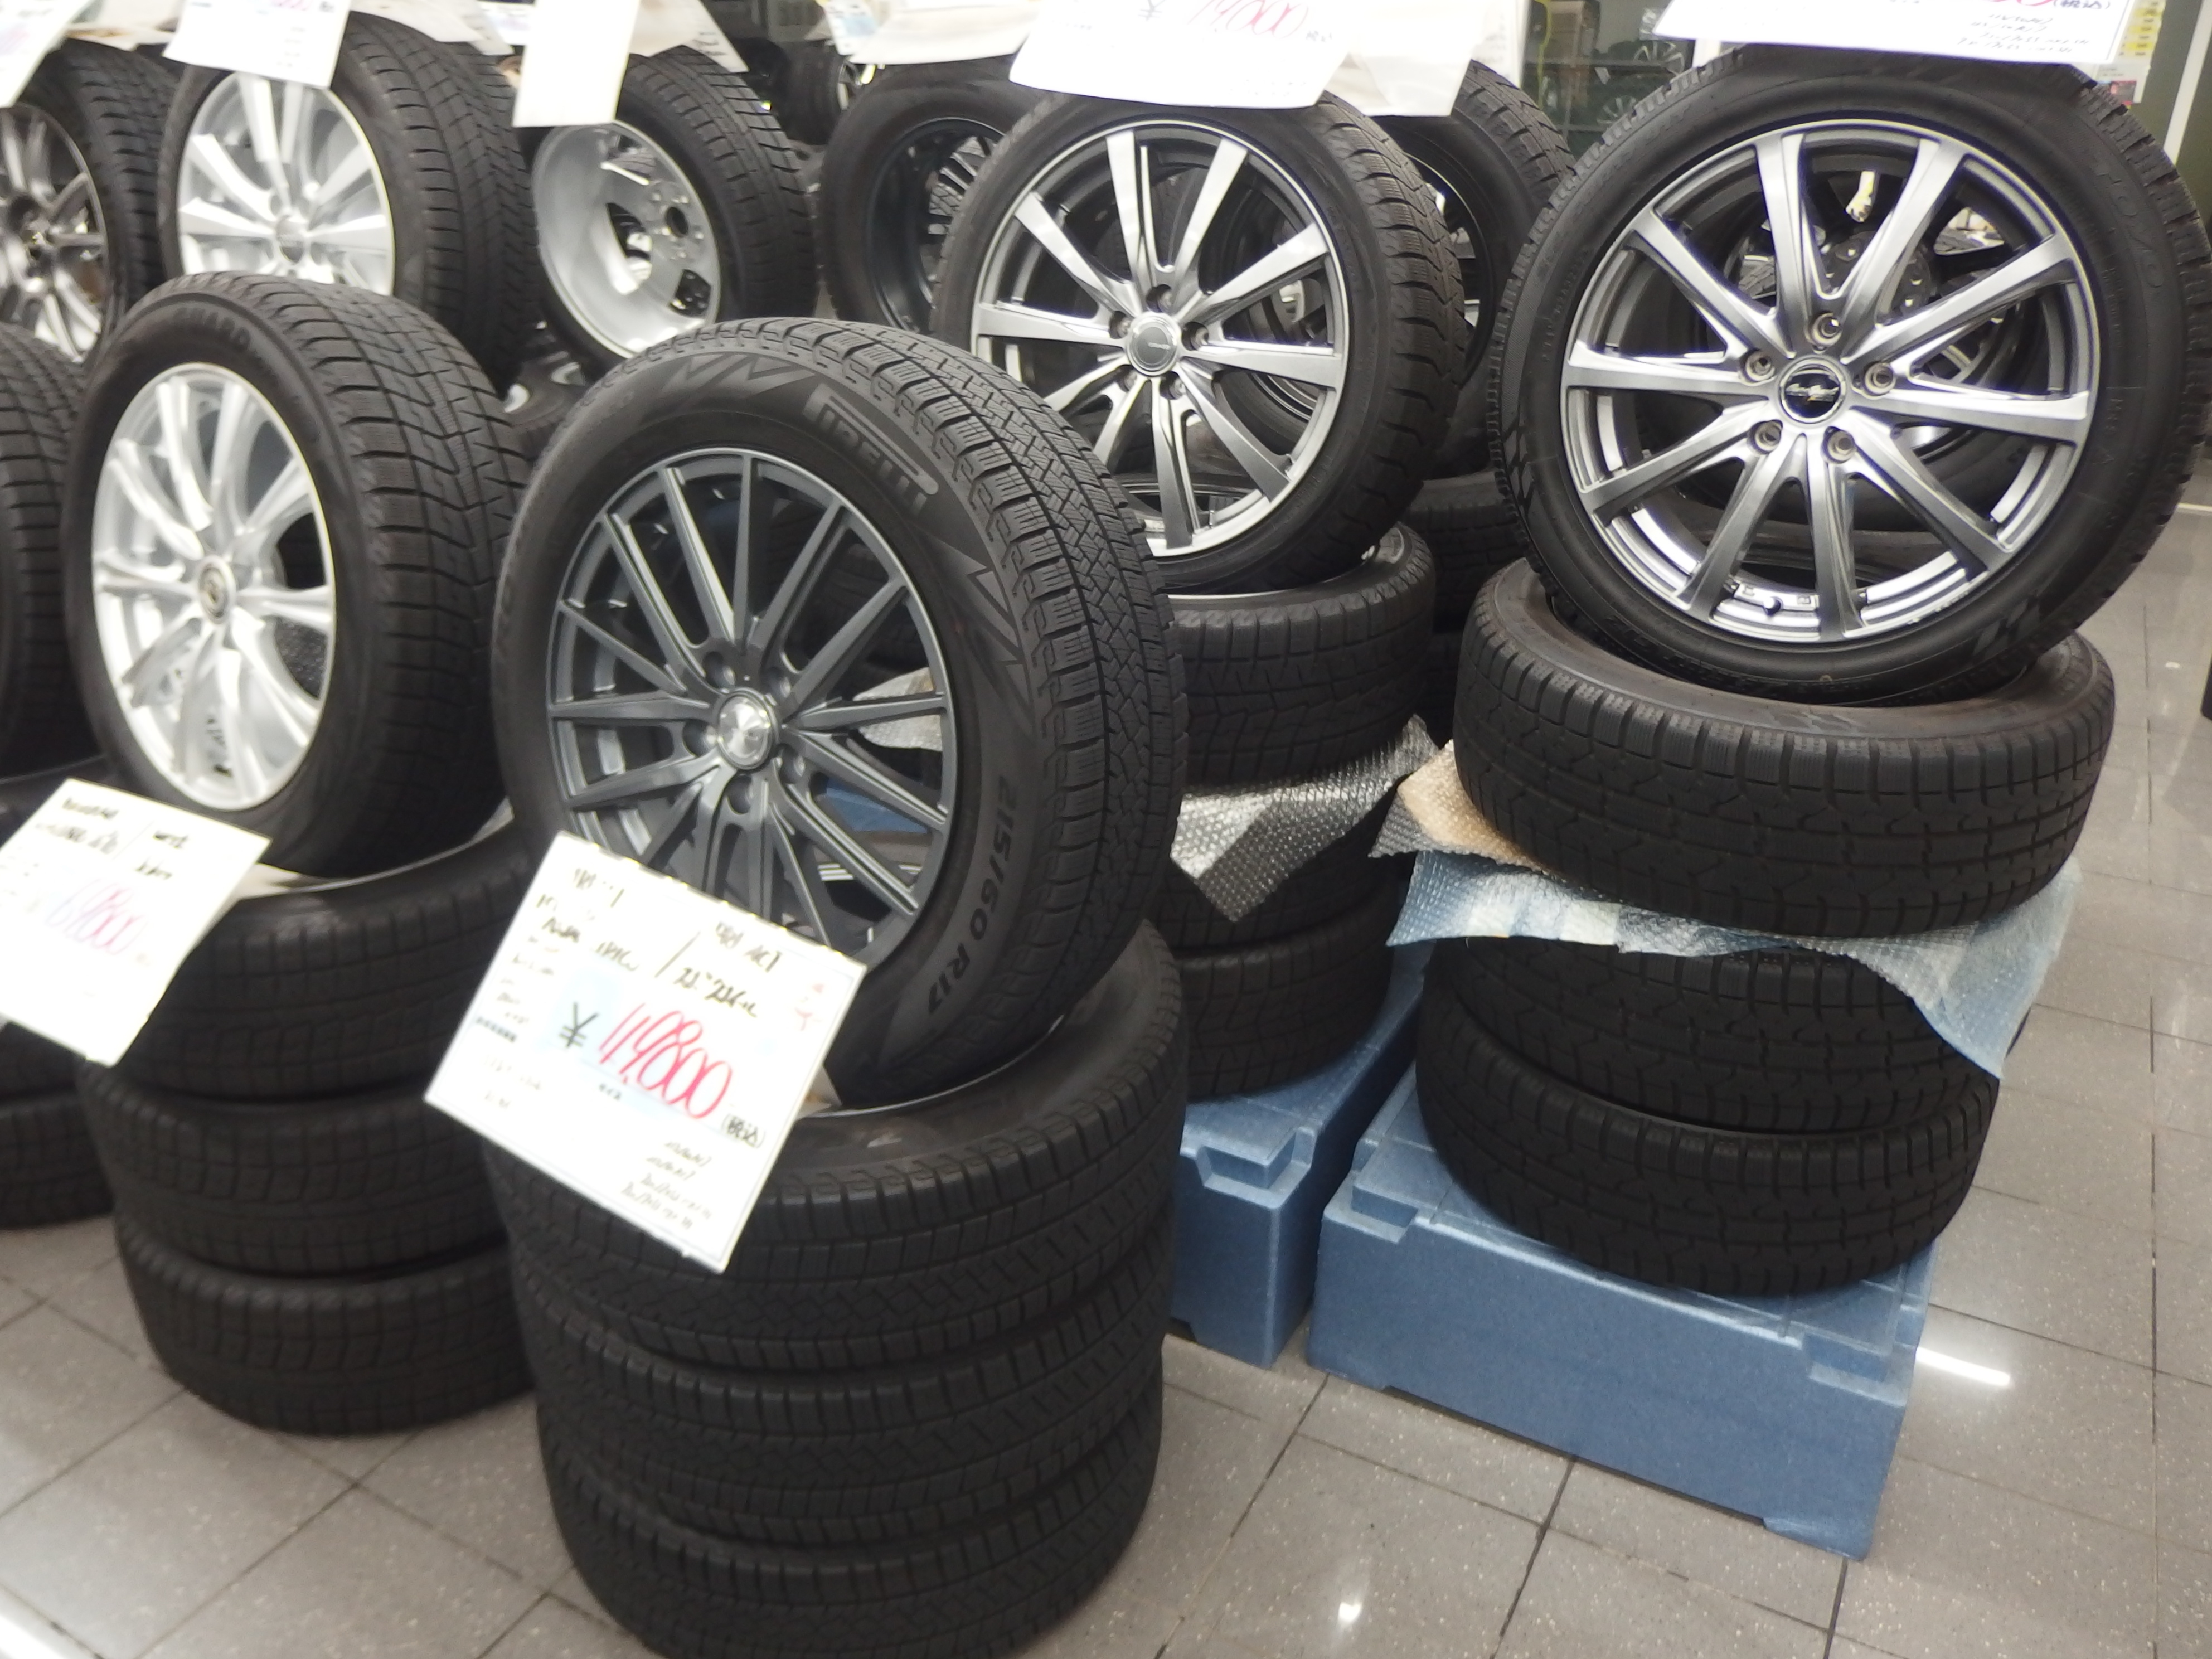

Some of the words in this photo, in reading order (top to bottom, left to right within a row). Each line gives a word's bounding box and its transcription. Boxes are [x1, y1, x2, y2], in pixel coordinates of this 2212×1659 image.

[802, 382, 939, 516] PIRELLI
[969, 775, 1017, 941] 215/60
[559, 1001, 599, 1049] ¥
[928, 942, 971, 1015] R17
